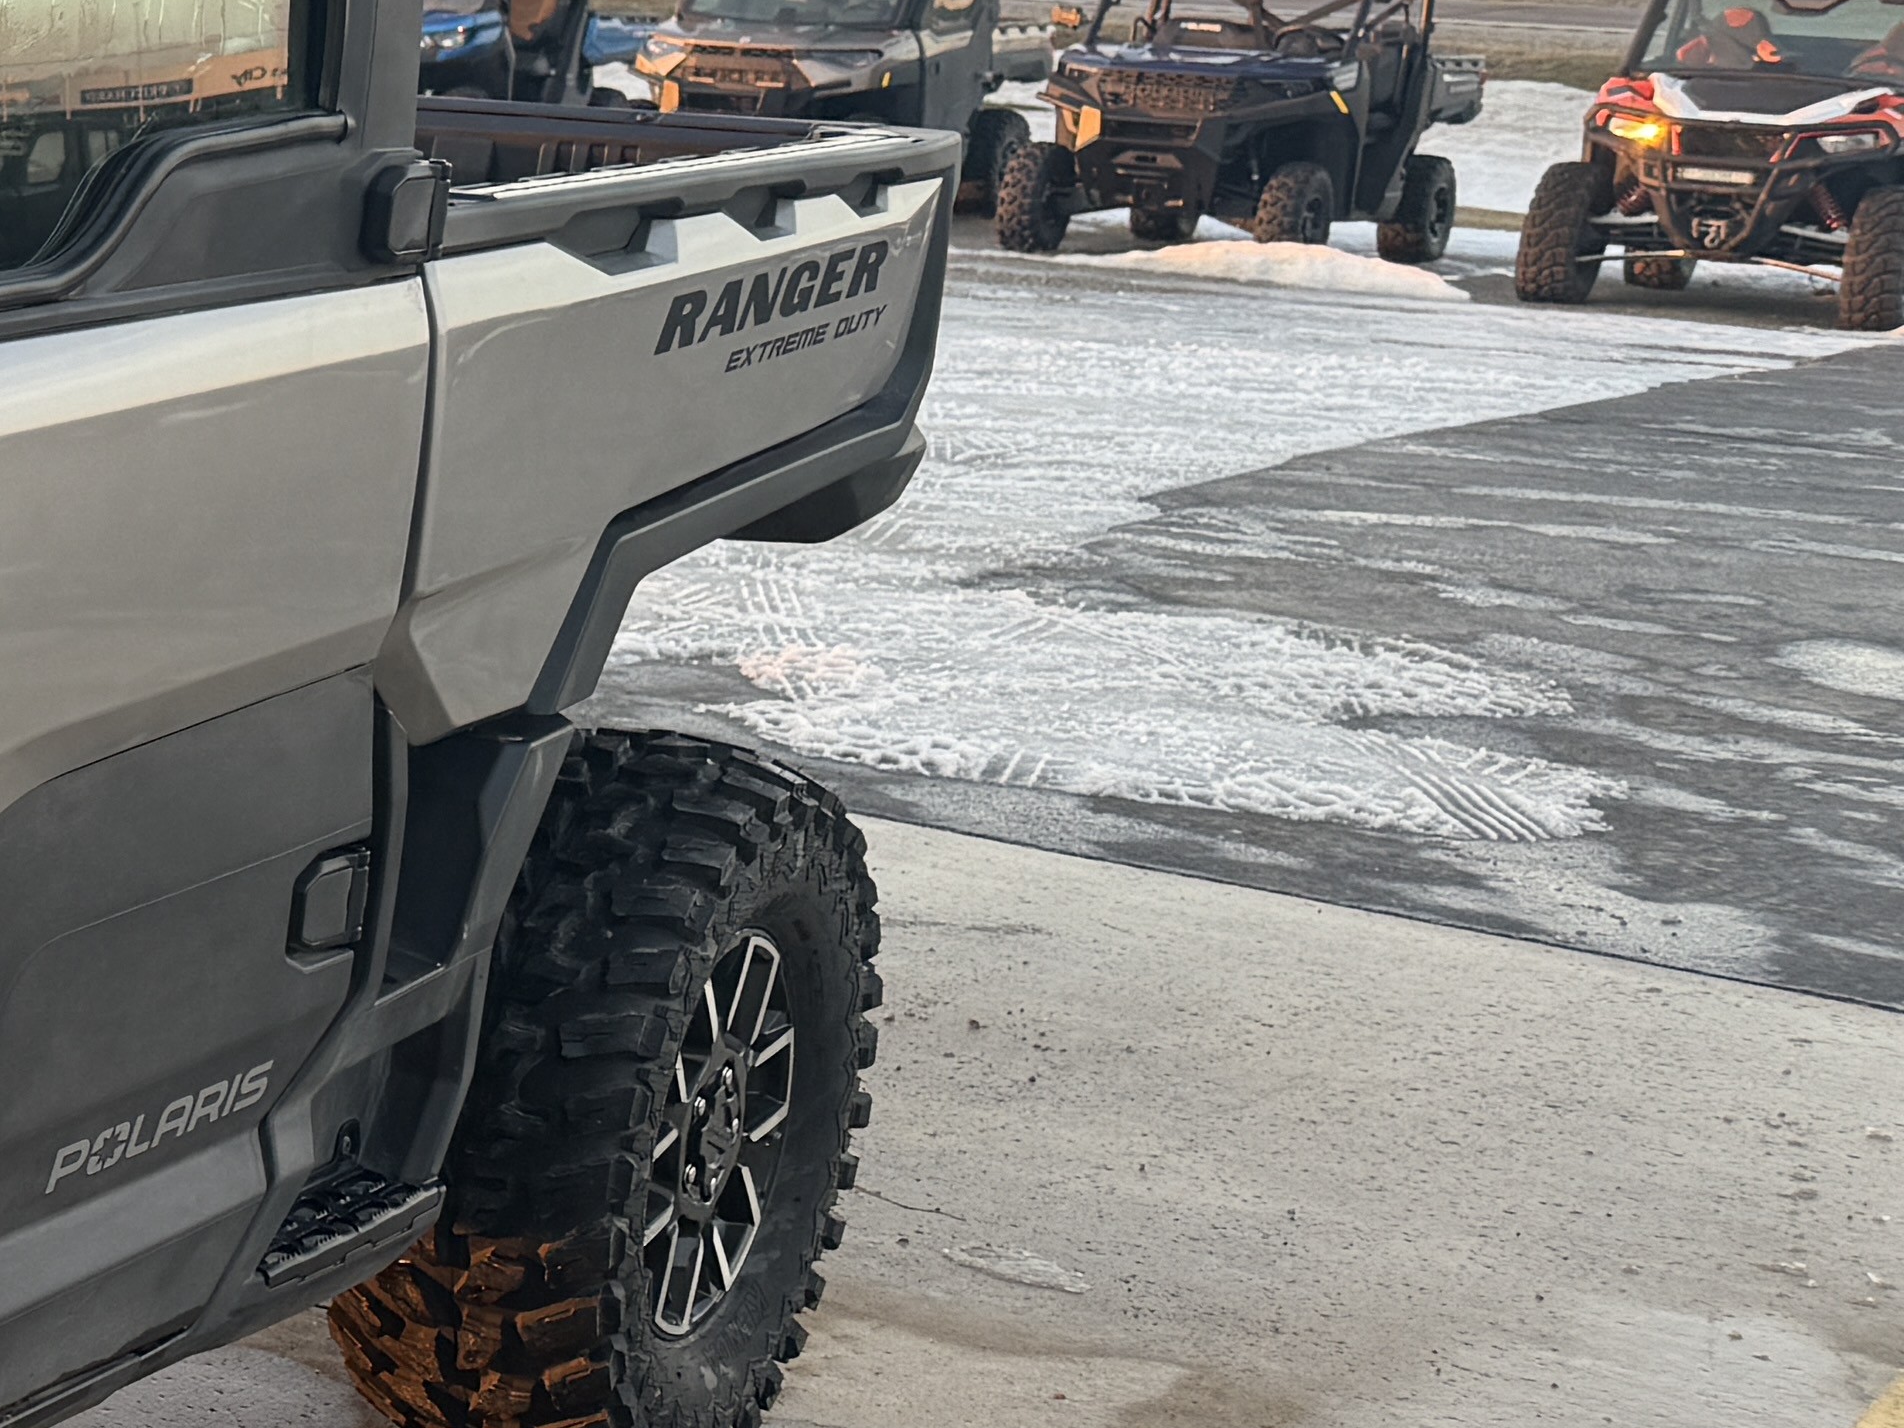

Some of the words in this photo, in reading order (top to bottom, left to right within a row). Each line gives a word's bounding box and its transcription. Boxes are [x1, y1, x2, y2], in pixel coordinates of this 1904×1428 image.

[654, 240, 889, 355] RANGER
[724, 322, 831, 373] EXTREME
[833, 304, 888, 339] DUTY
[44, 1059, 274, 1195] POLARIS
